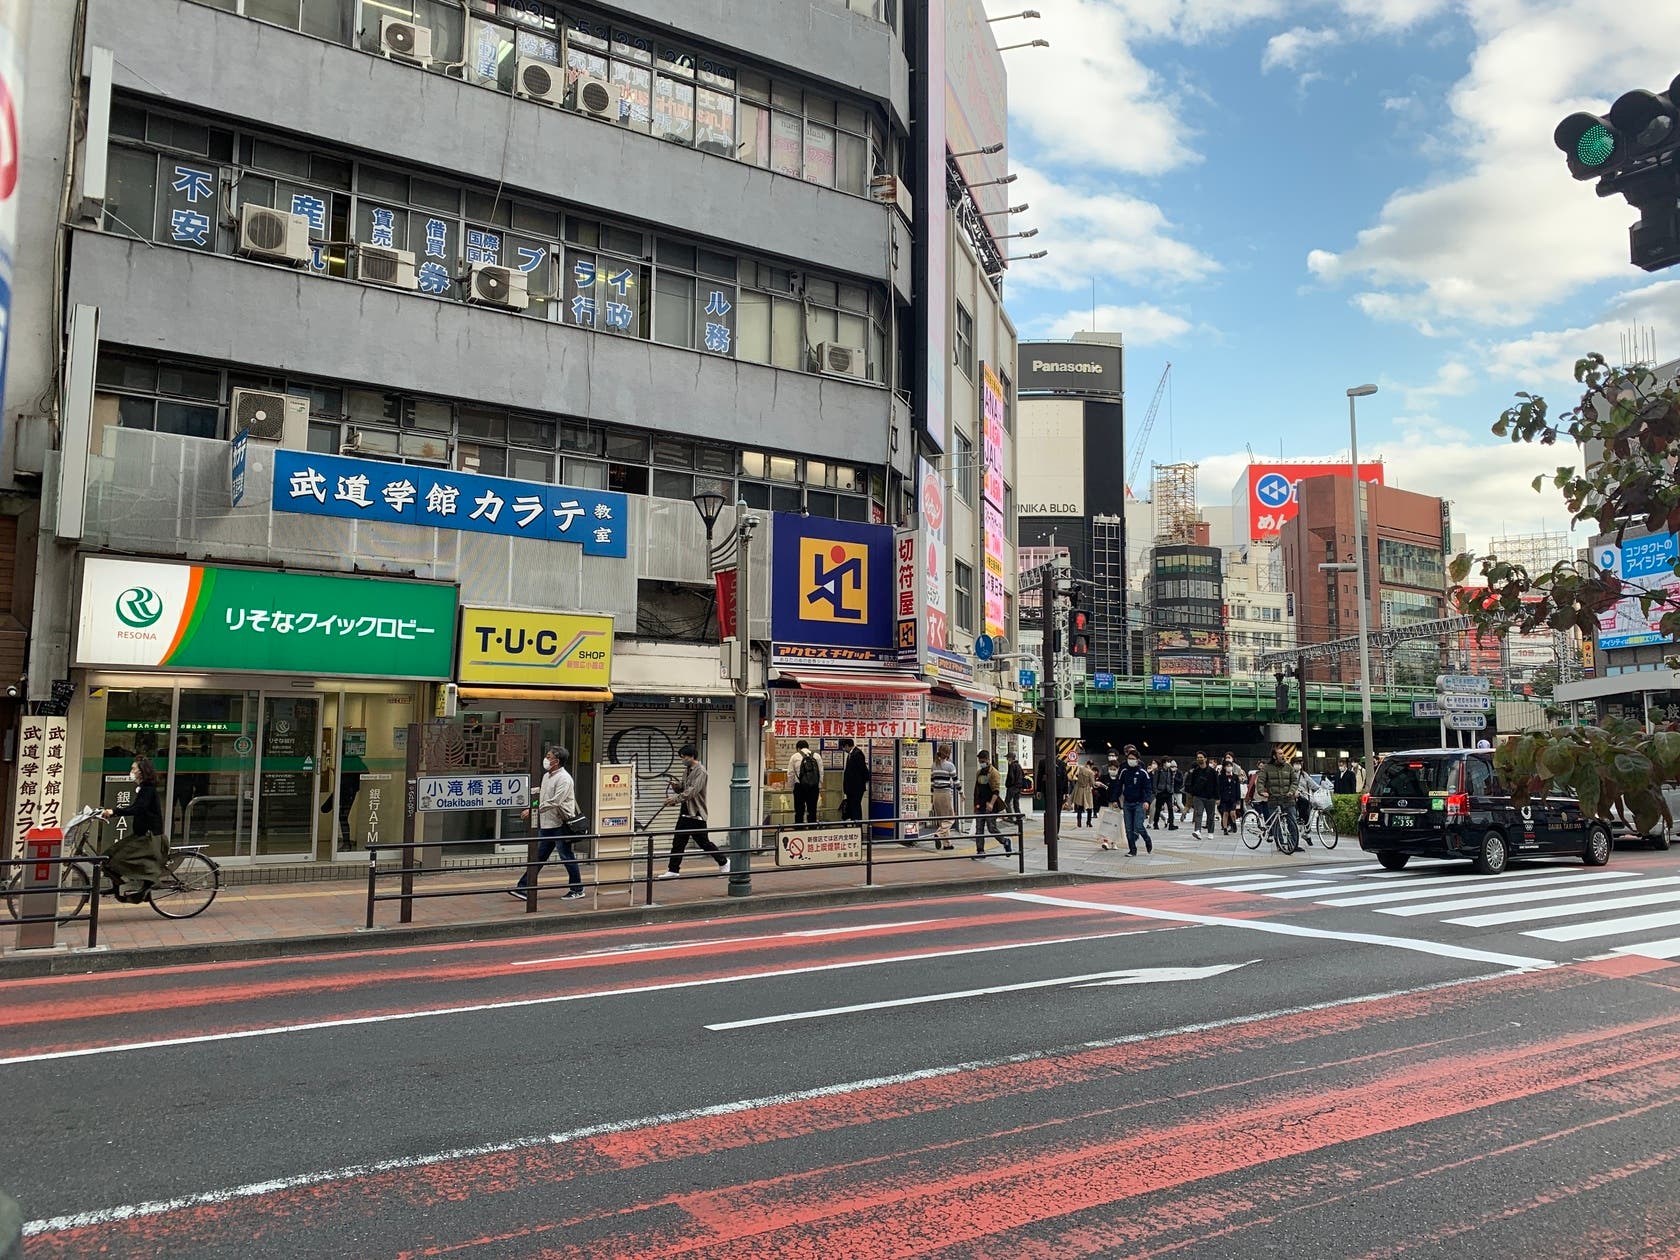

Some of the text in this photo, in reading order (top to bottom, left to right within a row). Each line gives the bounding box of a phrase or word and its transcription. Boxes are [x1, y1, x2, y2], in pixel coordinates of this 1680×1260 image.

[1032, 360, 1103, 374] Panasonic
[289, 466, 586, 533] 武道学館カラテ
[1050, 503, 1078, 513] BLDG.
[898, 538, 914, 616] 切符屋
[225, 606, 435, 640] りそなクイックロビー
[117, 630, 157, 641] RESONA
[578, 650, 606, 660] SHOP
[1015, 716, 1035, 730] 金券
[427, 778, 522, 797] 小滝橋通り
[436, 797, 484, 809] Otakibashi
[496, 796, 513, 806] dori
